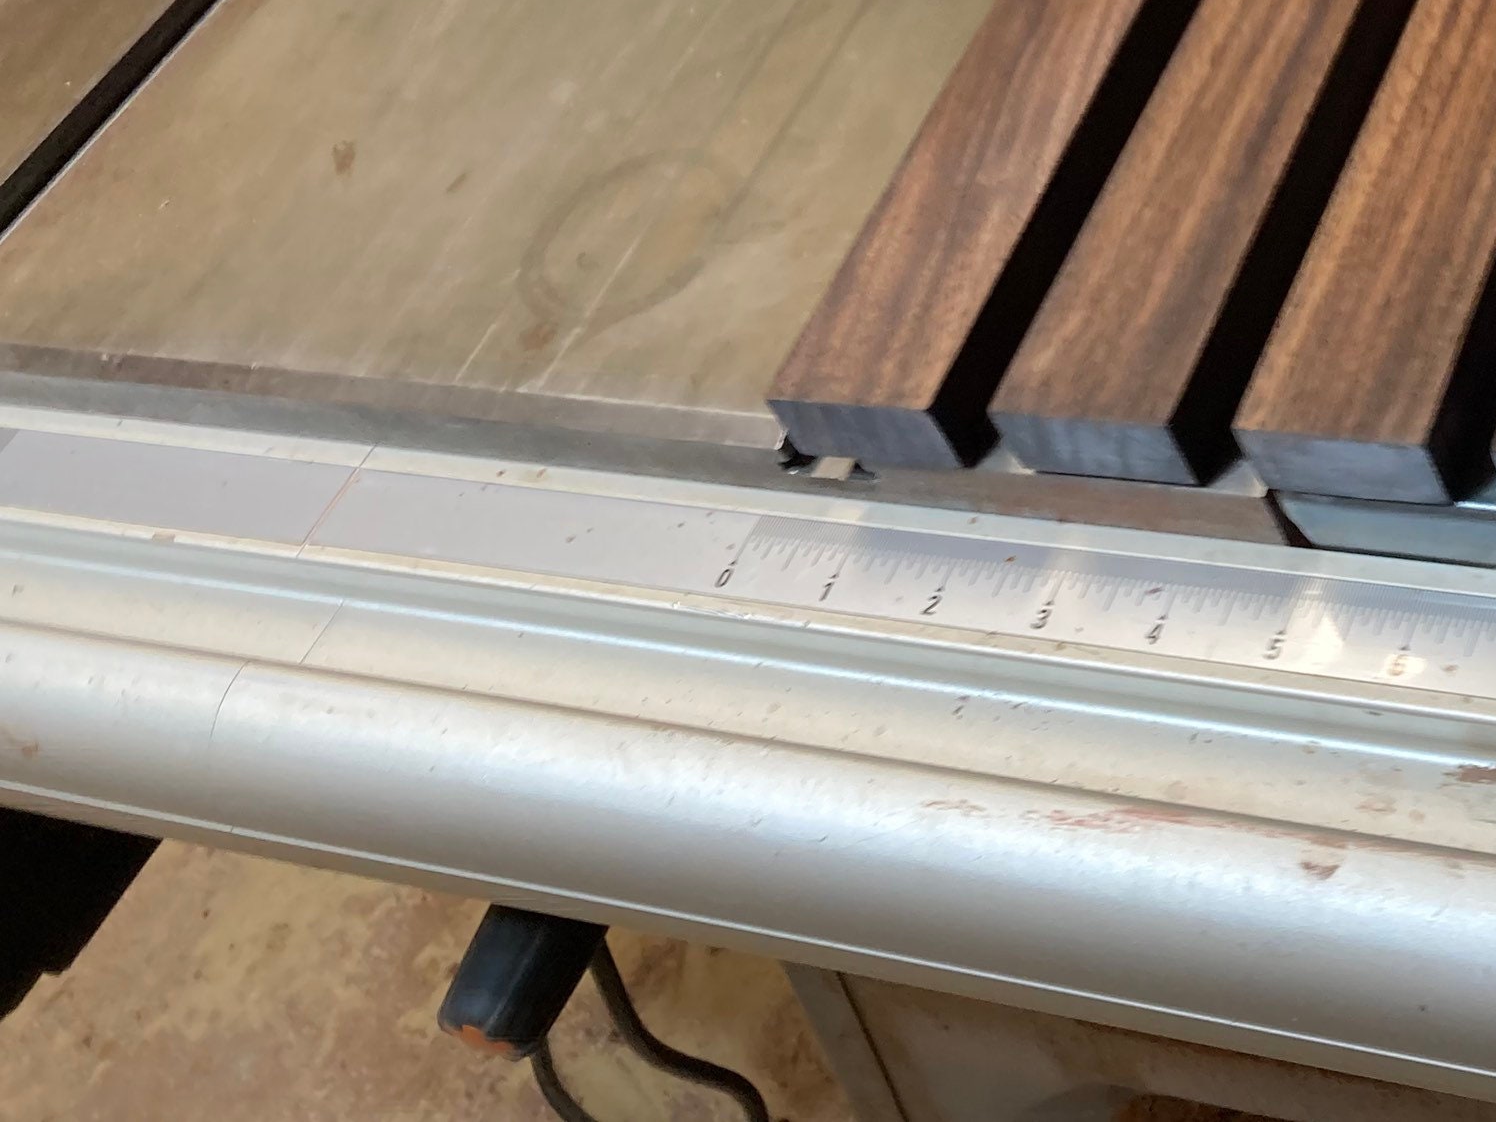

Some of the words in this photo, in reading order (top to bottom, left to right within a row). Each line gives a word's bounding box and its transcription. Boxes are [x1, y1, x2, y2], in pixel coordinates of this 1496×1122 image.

[715, 568, 733, 587] 0
[819, 581, 834, 601] 1
[921, 594, 943, 615] 2
[1030, 607, 1052, 629] 3
[1145, 622, 1164, 644] 4
[1263, 635, 1285, 659] 5
